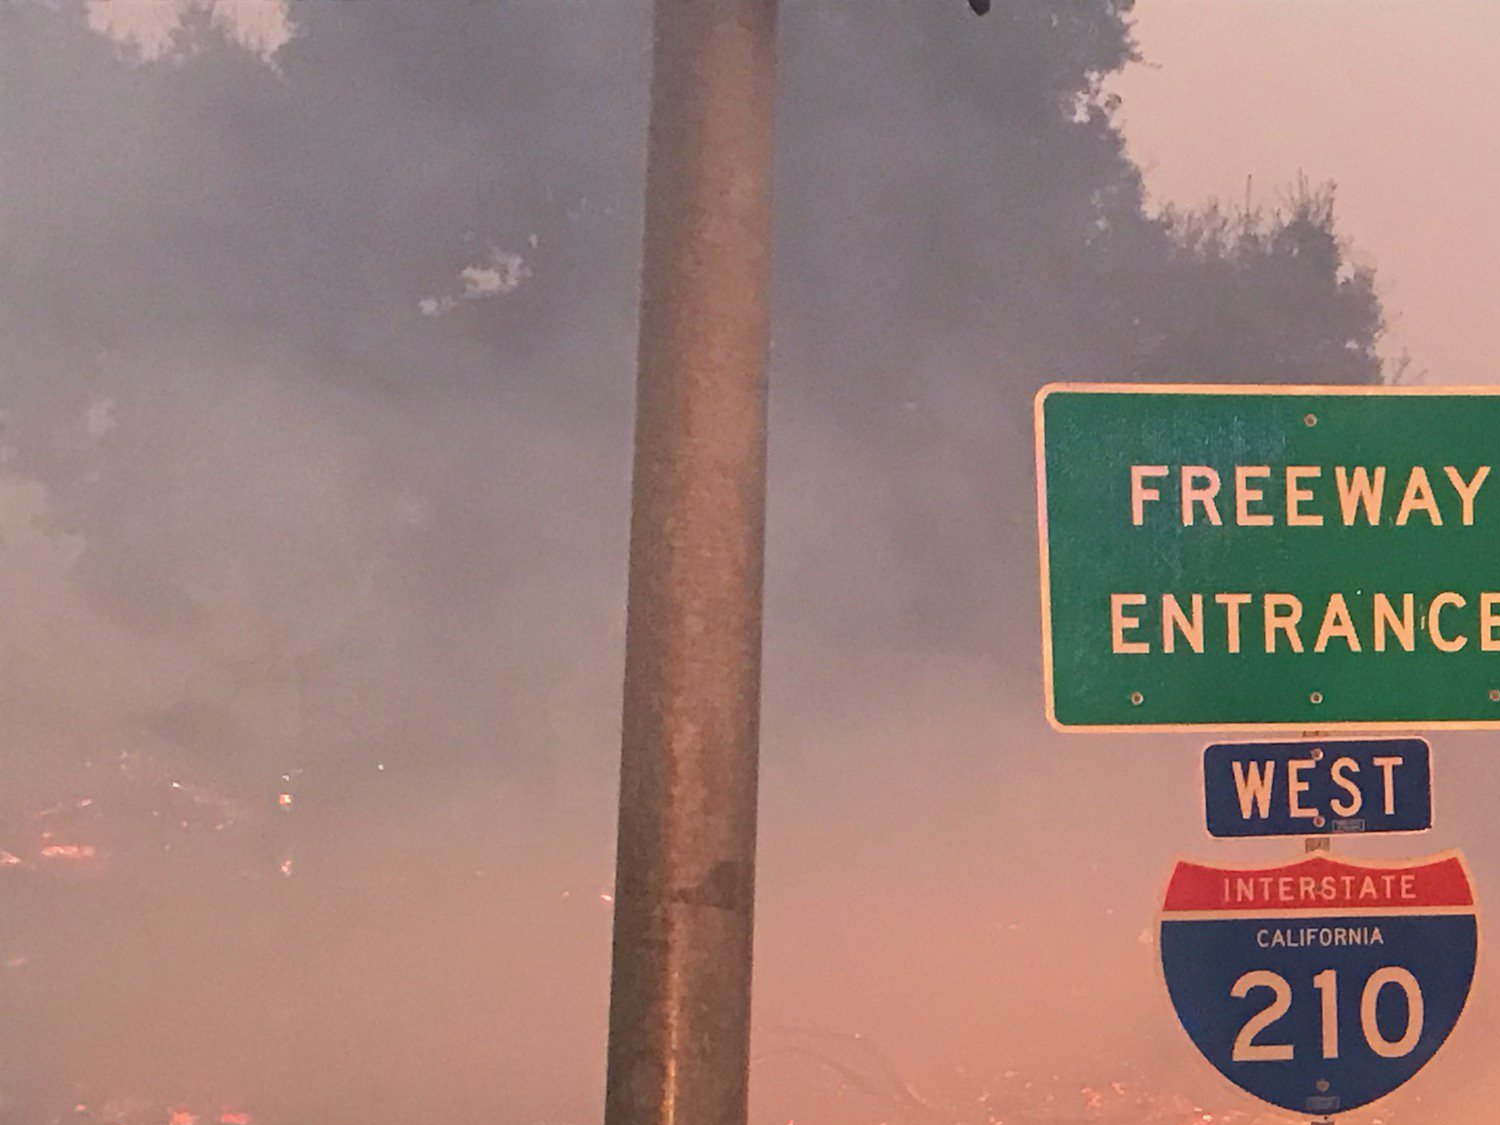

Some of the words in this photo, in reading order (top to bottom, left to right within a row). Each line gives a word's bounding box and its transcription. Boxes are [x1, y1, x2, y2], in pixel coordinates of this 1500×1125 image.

[1131, 464, 1491, 526] FREEWAY
[1232, 756, 1404, 820] WEST
[1223, 874, 1417, 902] INTERSTATE
[1256, 926, 1385, 948] CALIFORNIA
[1230, 965, 1425, 1062] 210
